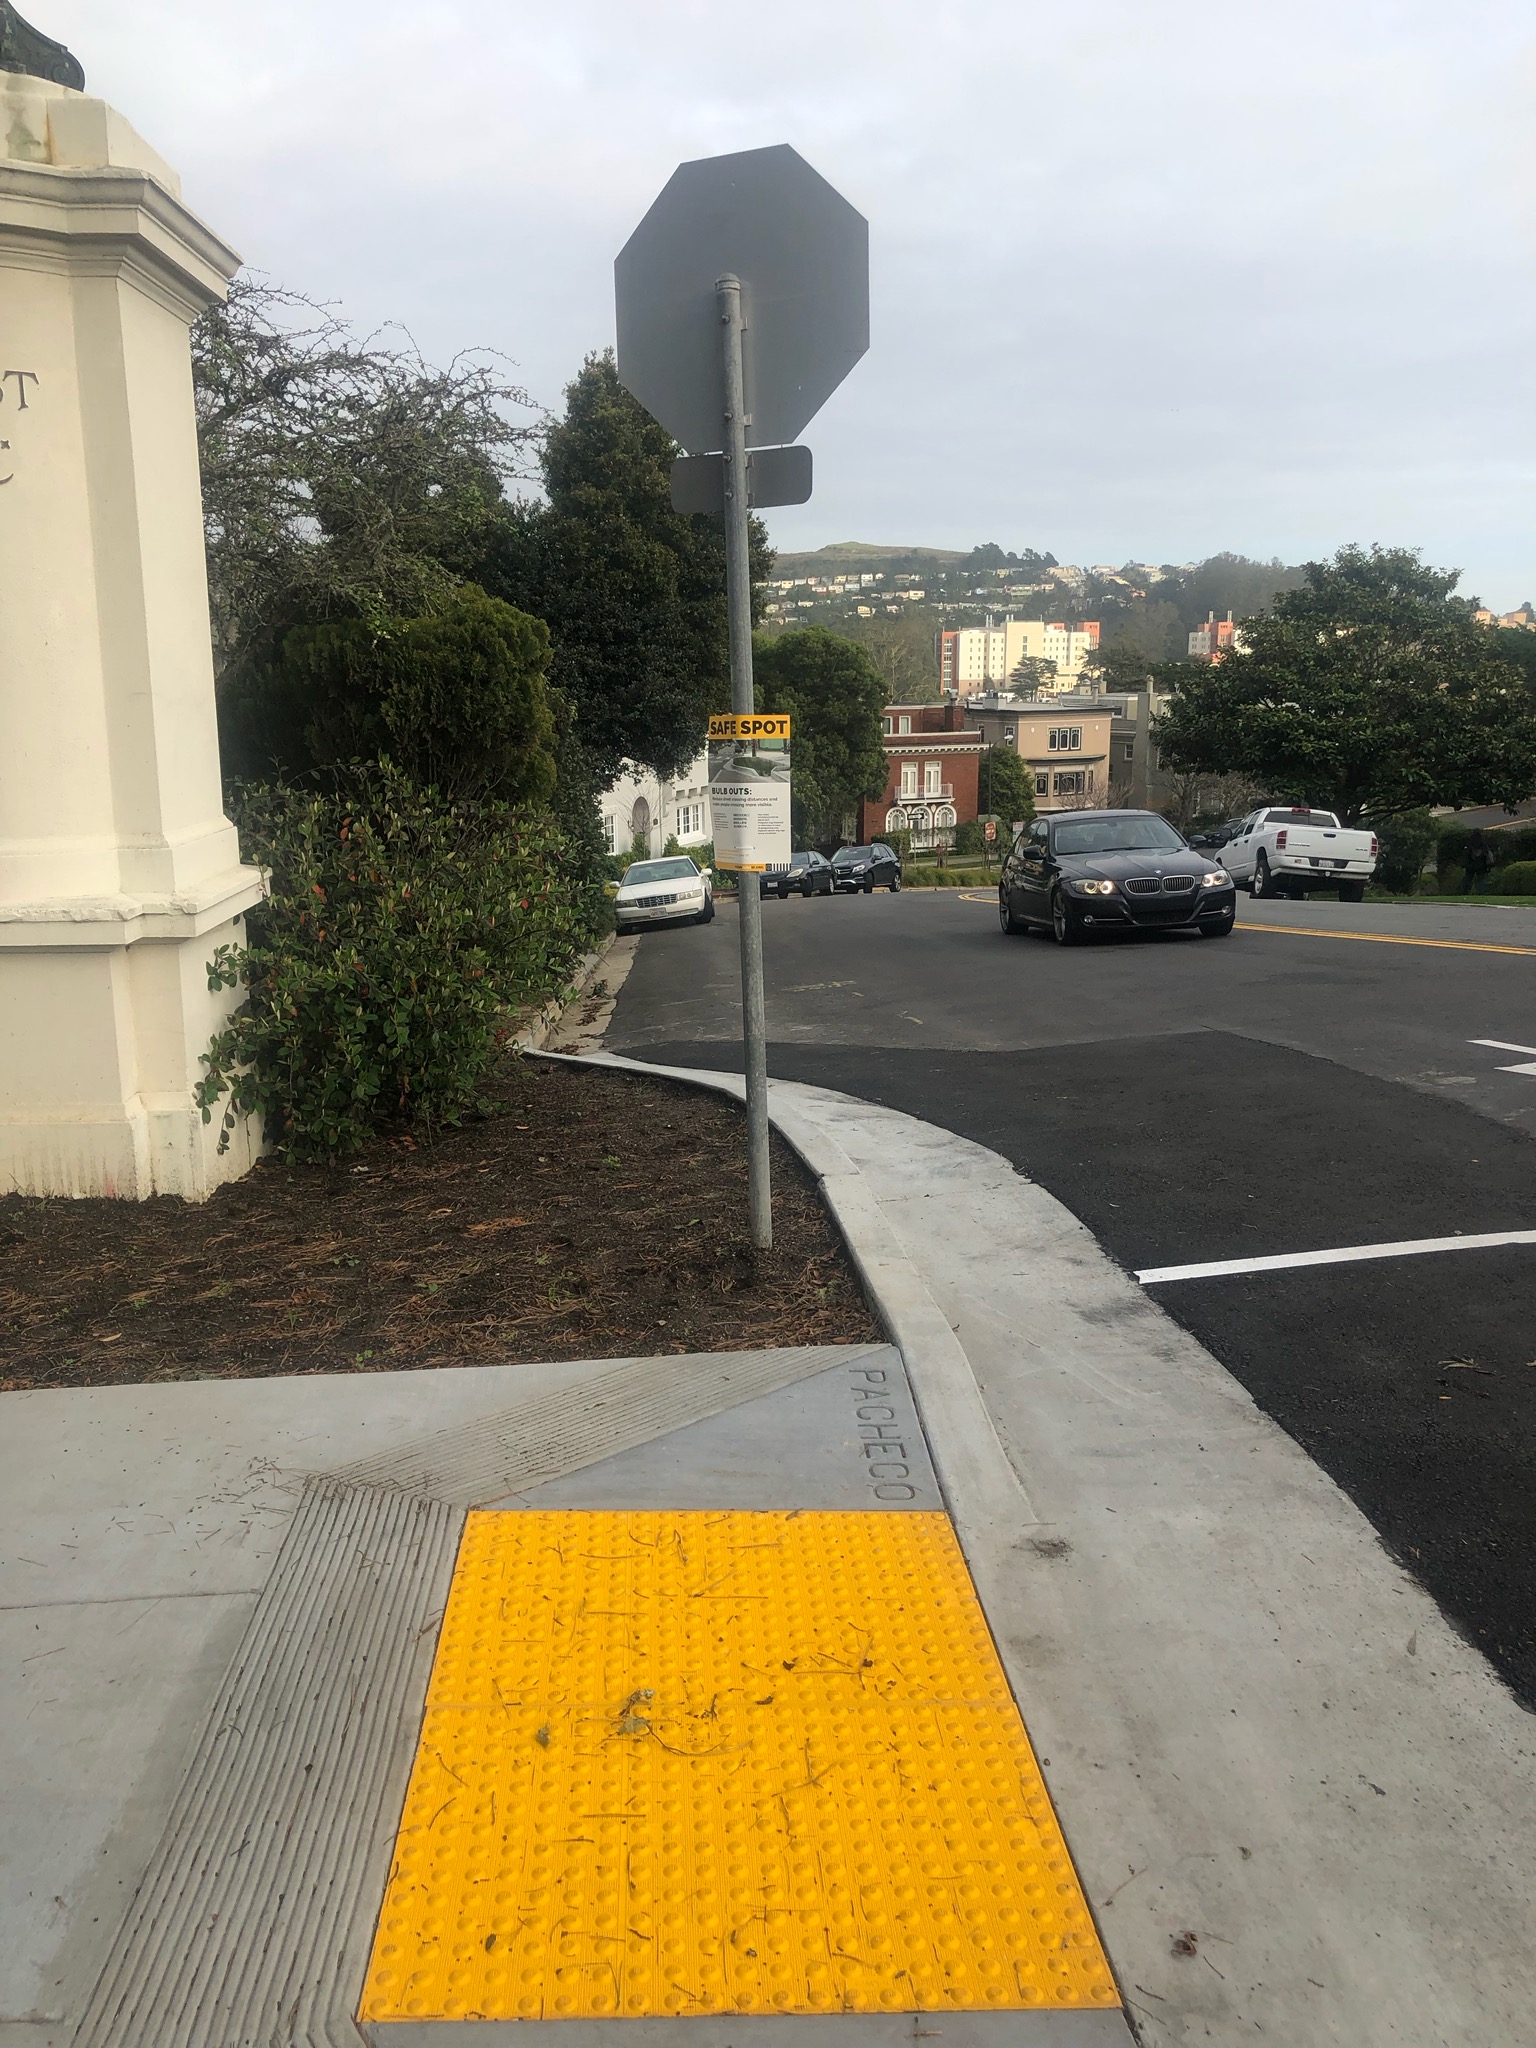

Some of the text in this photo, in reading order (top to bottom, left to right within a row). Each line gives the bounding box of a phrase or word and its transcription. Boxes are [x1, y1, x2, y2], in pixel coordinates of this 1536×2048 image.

[710, 720, 788, 735] SAFE SPOT
[712, 787, 752, 795] BULB OUTS:
[848, 1369, 916, 1501] PACHECO
